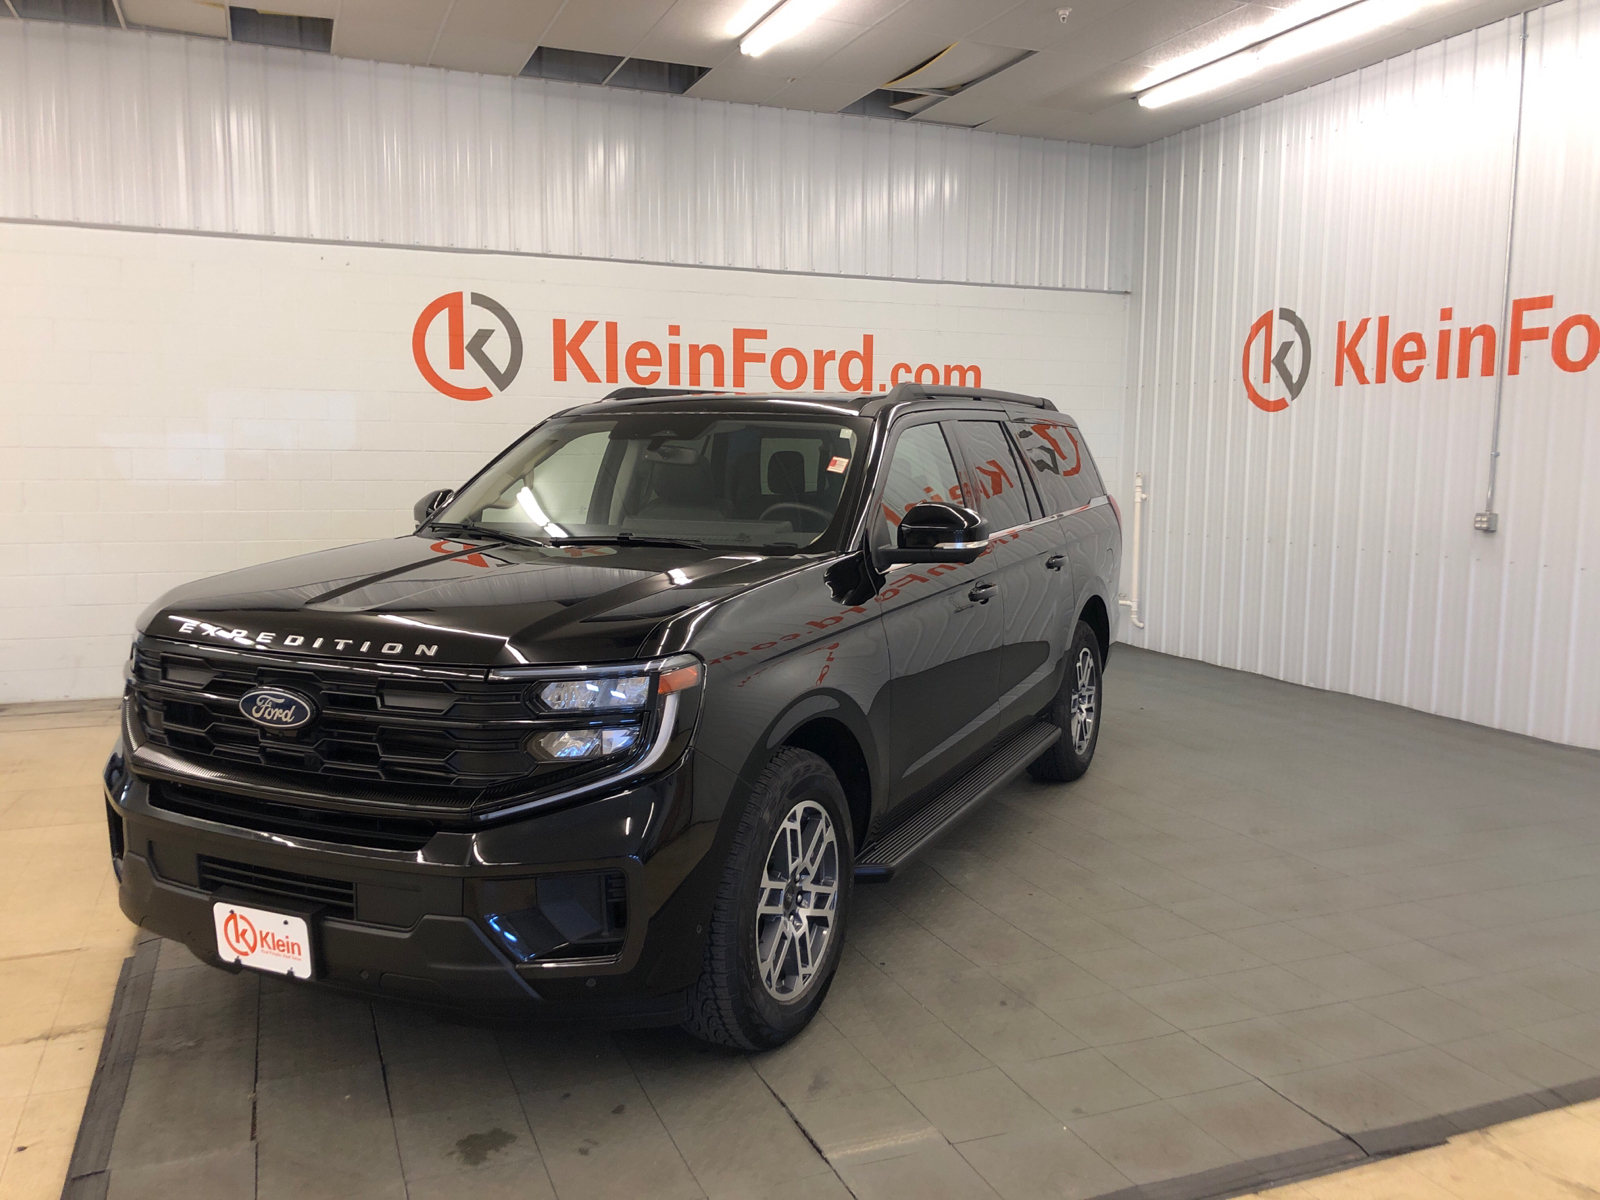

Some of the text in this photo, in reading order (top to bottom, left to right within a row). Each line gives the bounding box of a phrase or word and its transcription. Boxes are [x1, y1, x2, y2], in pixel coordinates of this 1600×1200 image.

[552, 318, 982, 392] KleinFord.com
[178, 621, 439, 657] EXPEDITION
[251, 694, 296, 722] Ford
[259, 930, 301, 956] Klein
